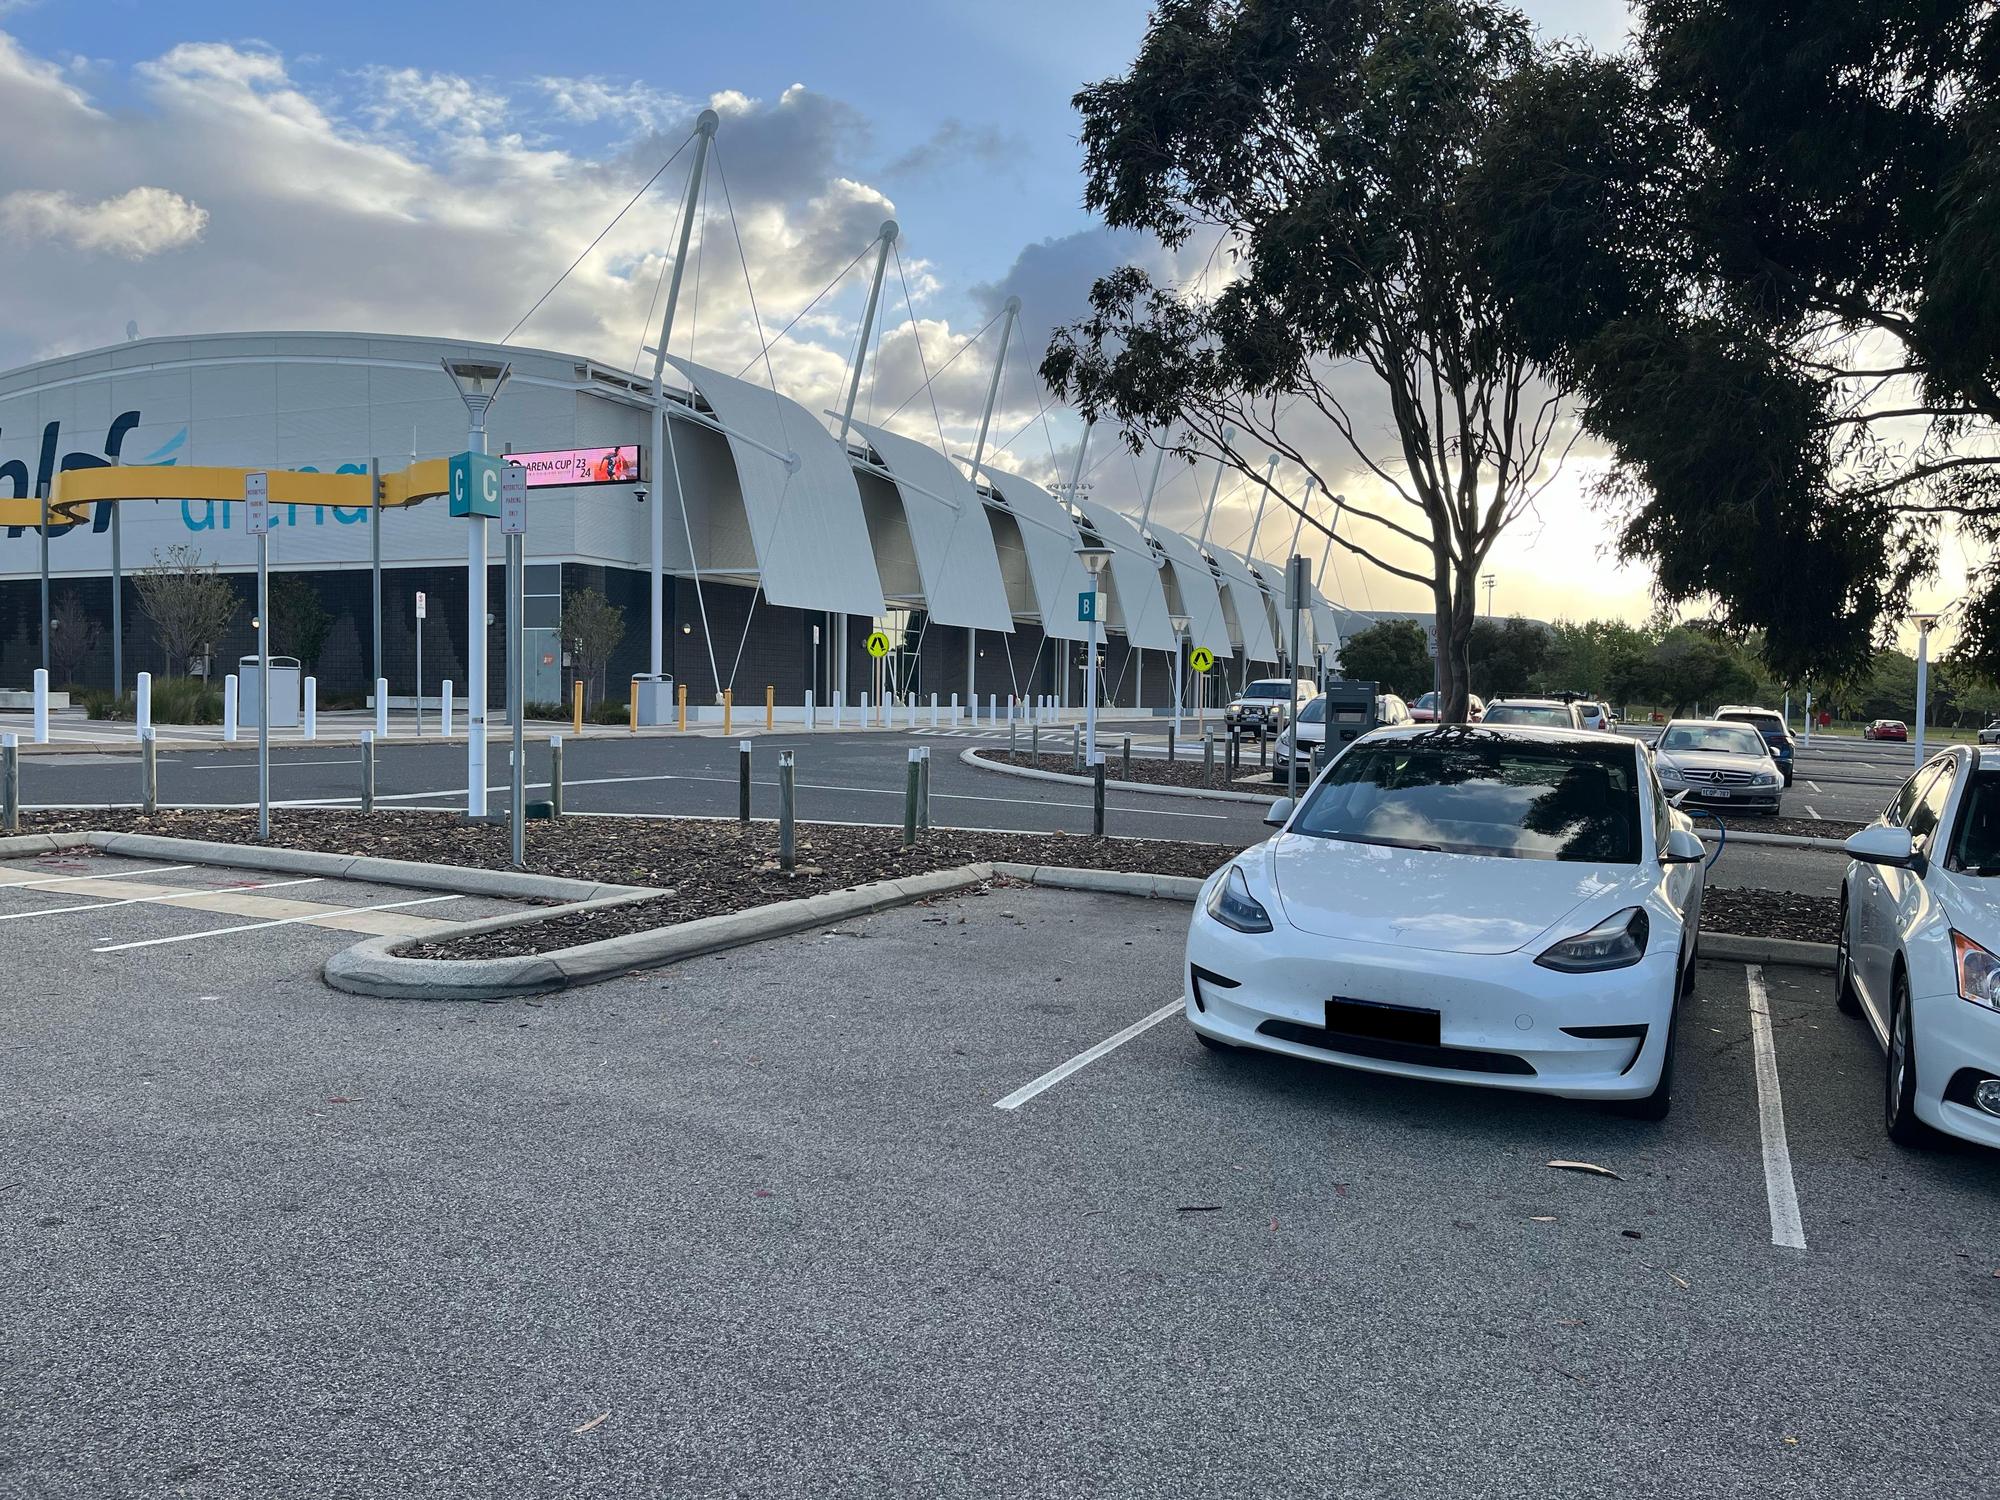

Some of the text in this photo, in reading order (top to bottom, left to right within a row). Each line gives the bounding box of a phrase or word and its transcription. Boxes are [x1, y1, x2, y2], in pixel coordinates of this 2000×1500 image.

[526, 459, 586, 472] ARENA CUP 23
[580, 468, 591, 477] 24
[455, 468, 463, 502] C
[483, 469, 497, 502] C
[1083, 599, 1090, 614] B
